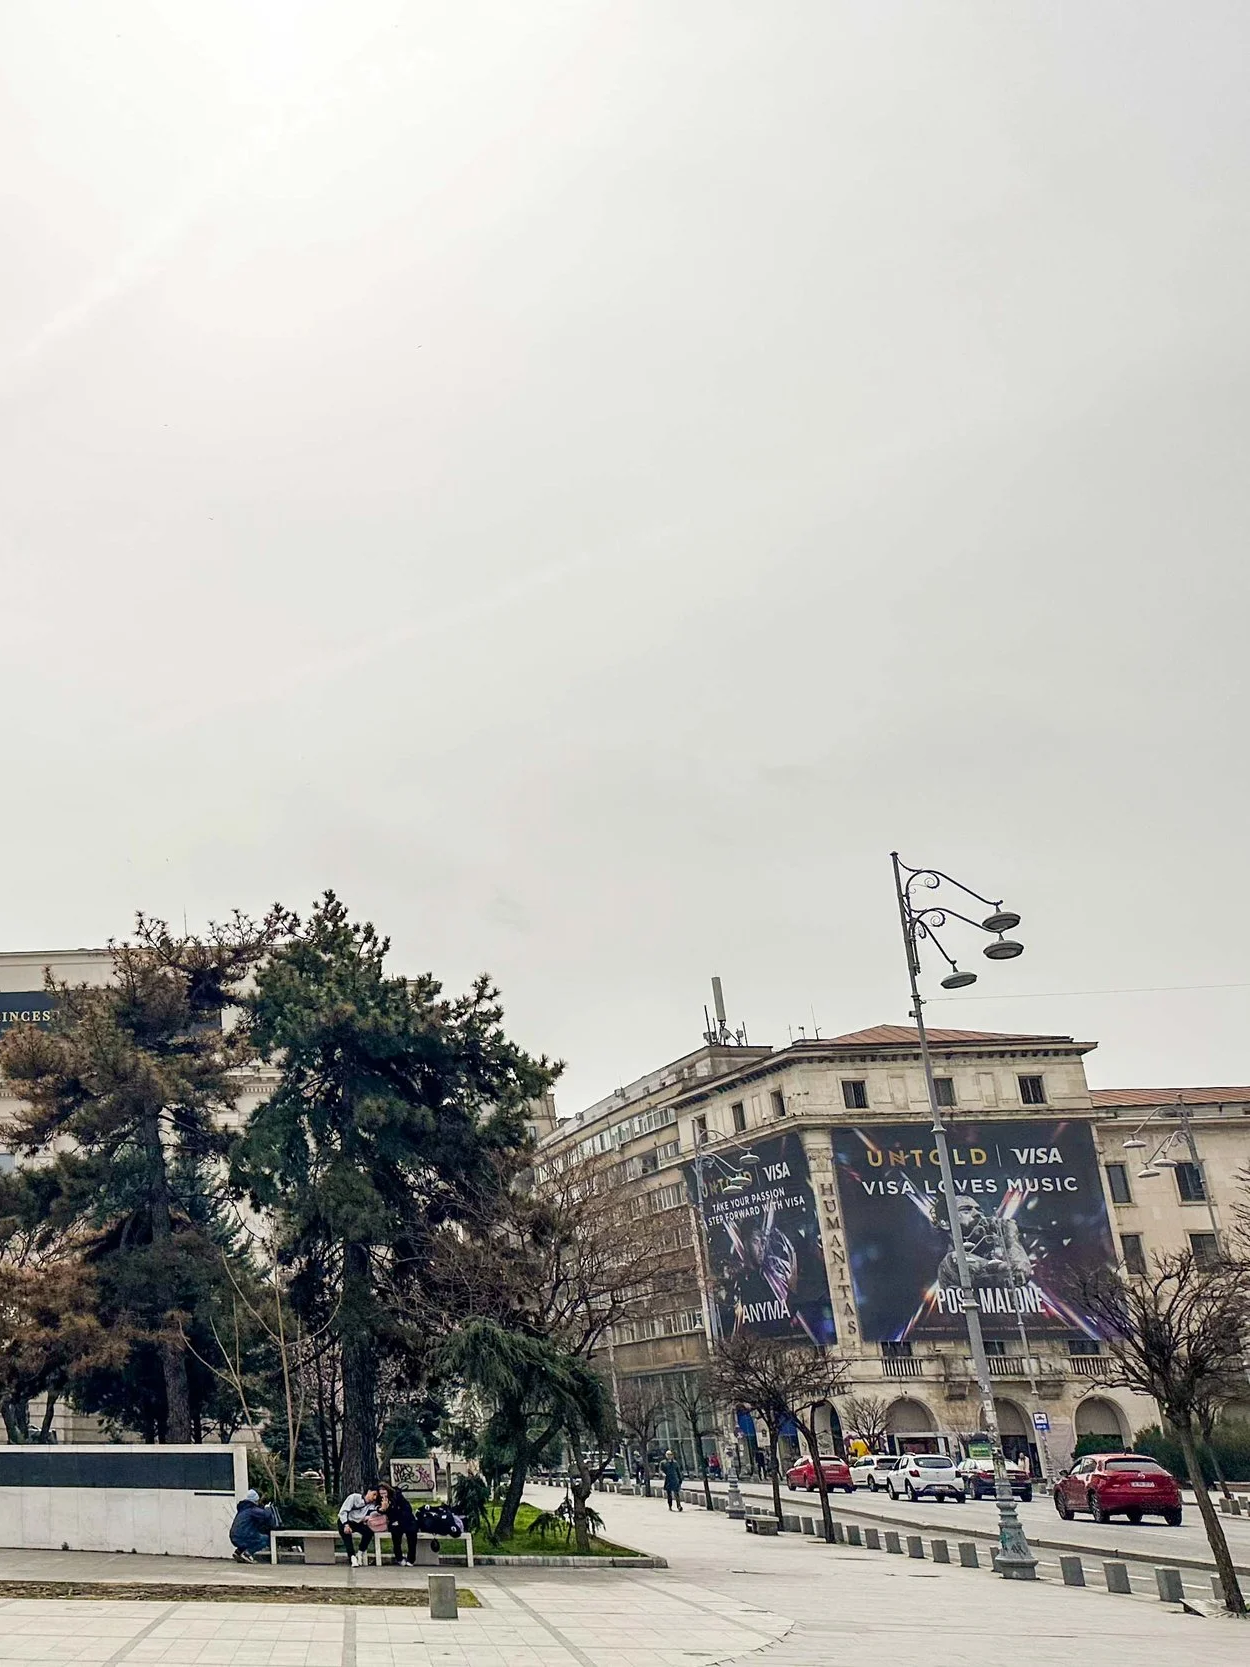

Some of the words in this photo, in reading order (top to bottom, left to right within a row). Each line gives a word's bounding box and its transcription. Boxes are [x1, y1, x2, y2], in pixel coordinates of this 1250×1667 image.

[867, 1148, 988, 1168] UNTOLD
[1010, 1148, 1063, 1165] VISA
[762, 1161, 791, 1182] VISA
[862, 1180, 915, 1196] VISA
[1006, 1176, 1079, 1192] MUSIC
[708, 1214, 724, 1227] STEP
[724, 1205, 760, 1222] FORWARD
[761, 1200, 784, 1213] WITH
[784, 1195, 806, 1208] VISA
[712, 1200, 730, 1213] TAKE
[730, 1195, 750, 1209] YOUR
[751, 1186, 786, 1204] PASSION
[819, 1183, 857, 1335] HUMANITAS
[742, 1298, 791, 1324] ANYMA
[936, 1287, 974, 1314] POS
[978, 1286, 1047, 1315] MALONE
